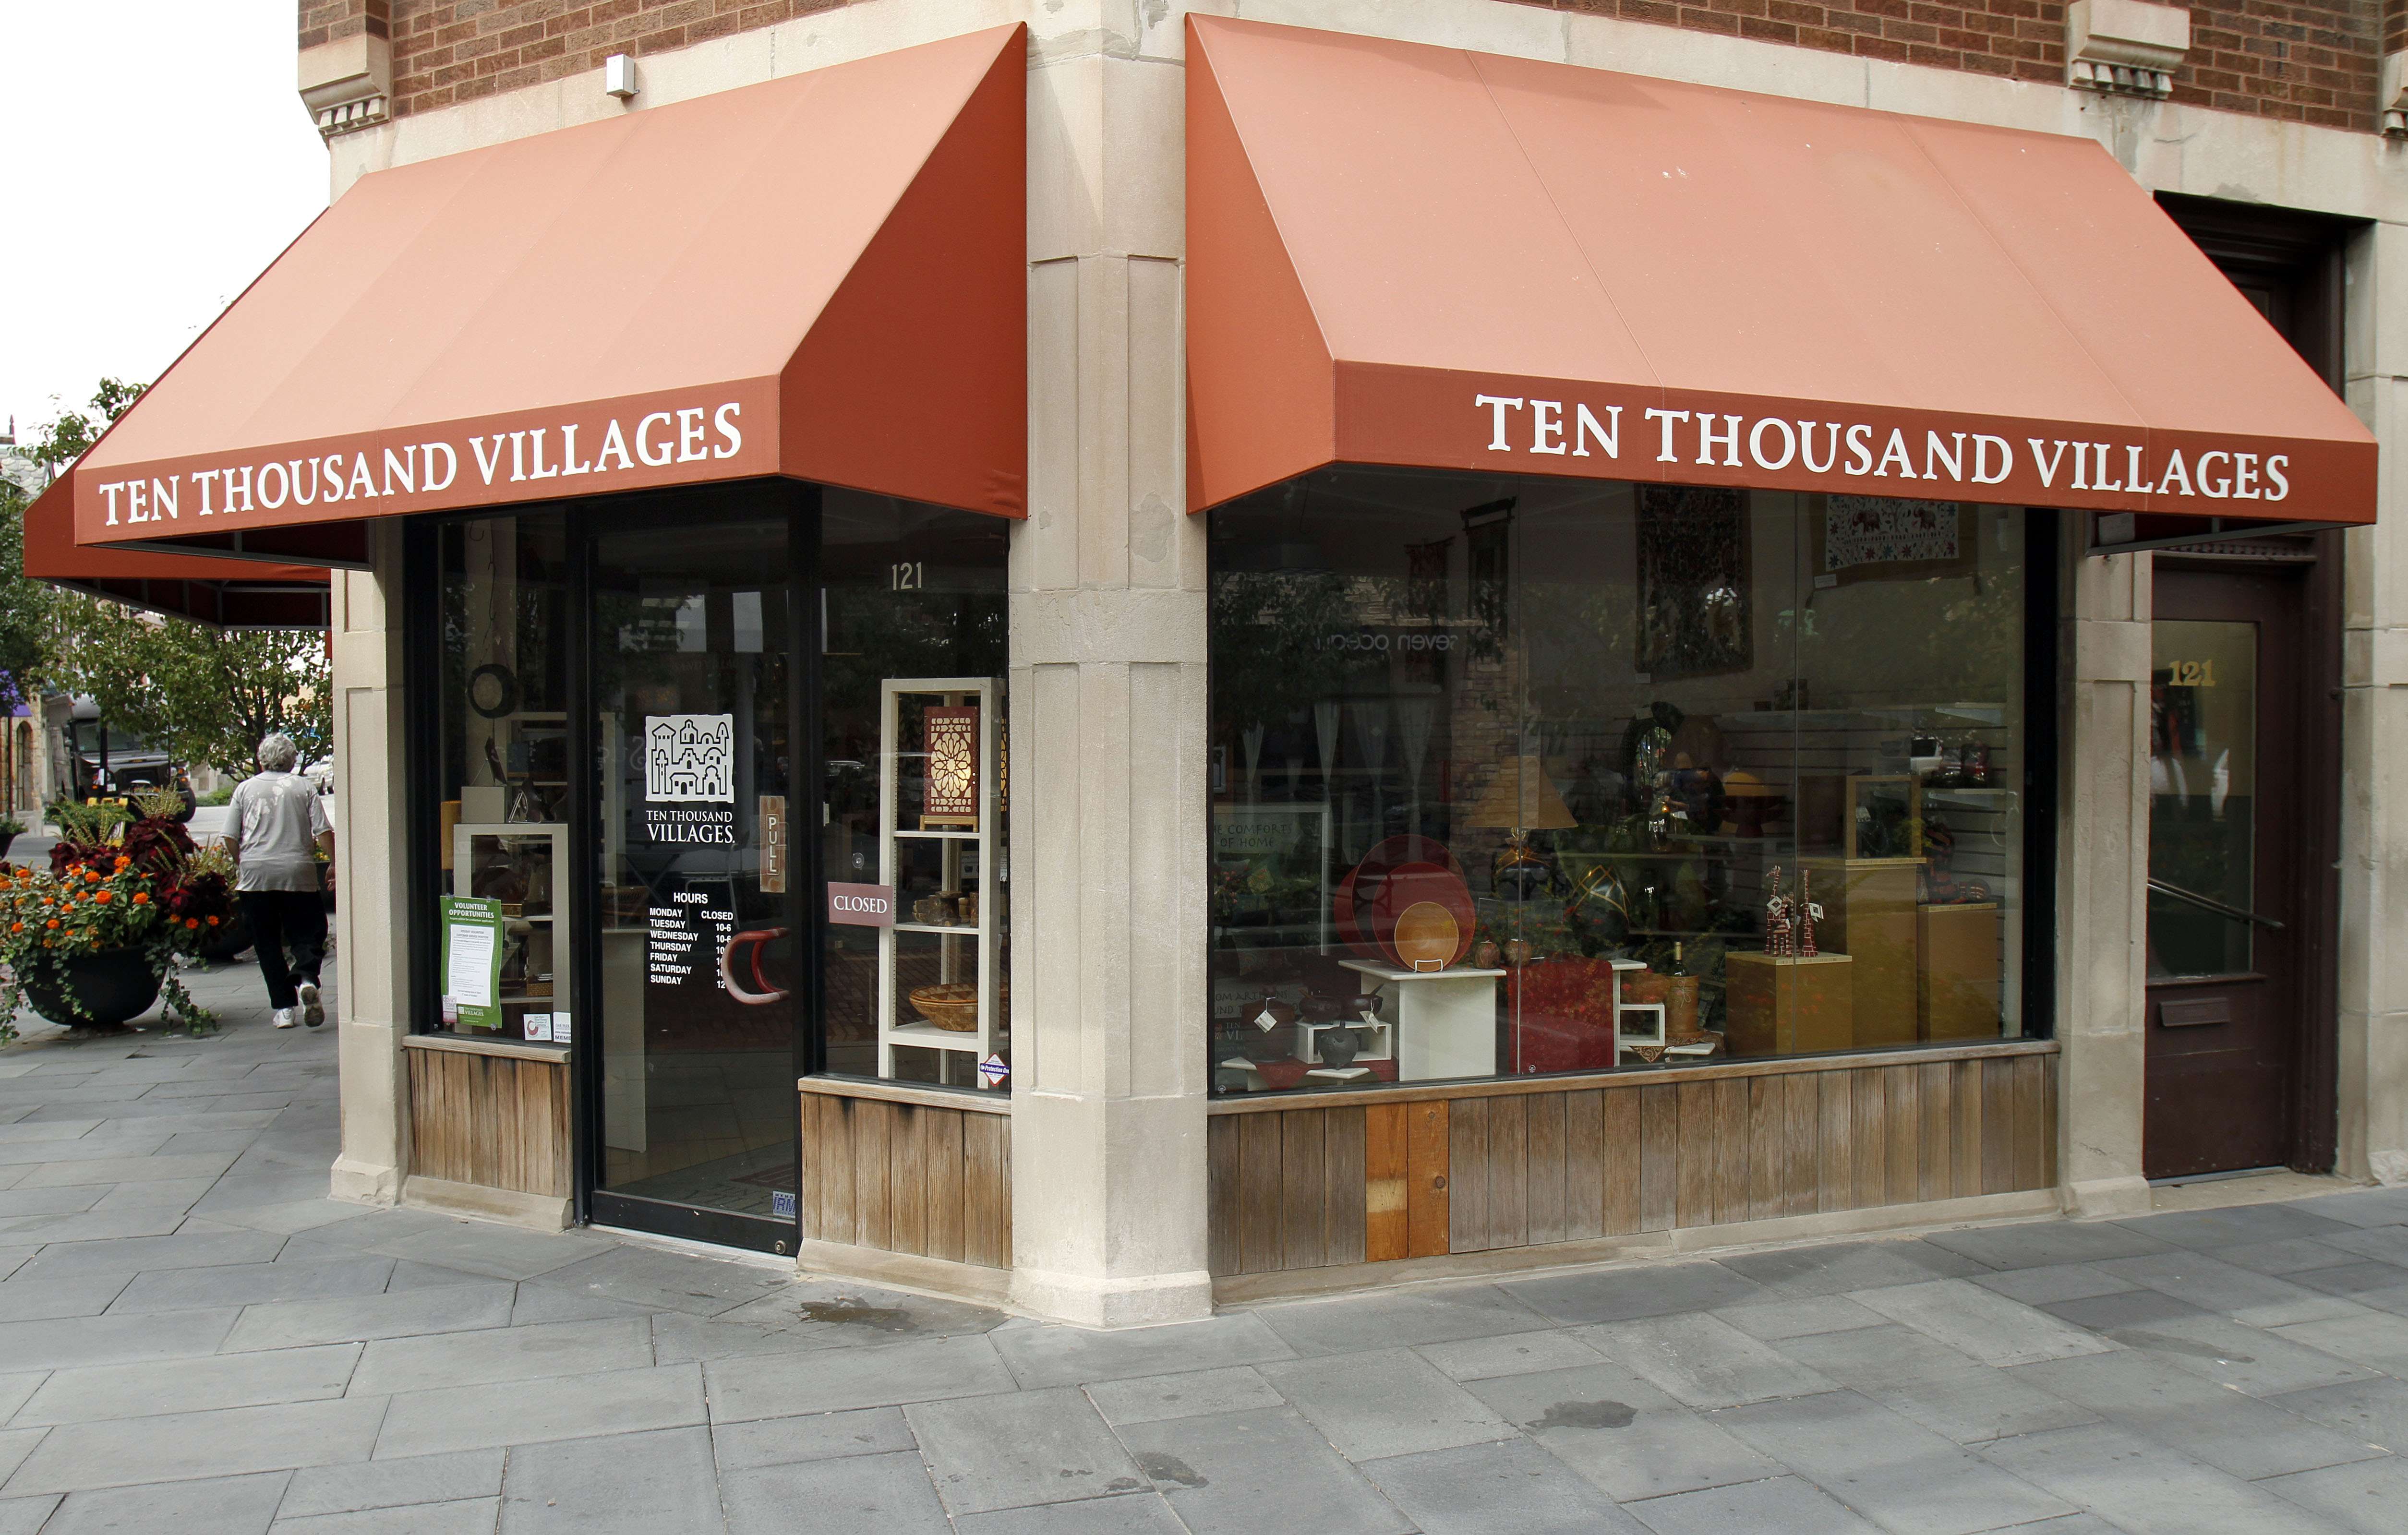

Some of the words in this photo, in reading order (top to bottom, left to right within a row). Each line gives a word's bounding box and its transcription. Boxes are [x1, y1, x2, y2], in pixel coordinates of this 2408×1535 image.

[1475, 394, 1623, 459] TEN
[1645, 407, 2014, 484] THOUSAND
[2027, 438, 2289, 501] VILLAGES
[98, 475, 180, 527] TEN
[192, 440, 458, 516] THOUSAND
[468, 402, 742, 486] VILLAGES
[891, 562, 922, 590] 121
[2168, 659, 2216, 687] 121
[646, 810, 667, 821] TEN
[669, 810, 733, 823] THOUSAND
[1228, 824, 1292, 835] COMFORTS
[768, 817, 777, 873] PULL
[1220, 837, 1234, 848] OF
[1240, 837, 1276, 848] HOME
[673, 892, 709, 904] HOURS
[833, 895, 887, 914] CLOSED
[454, 902, 488, 911] VOLUNTEER
[449, 909, 494, 919] OPPORTUNITIES
[650, 907, 683, 918] MONDAY
[701, 911, 734, 920] CLOSED
[650, 919, 686, 929] TUESDAY
[715, 923, 732, 932] 10-6
[650, 930, 699, 941] WEDNESDAY
[716, 935, 731, 943] 10-6
[650, 941, 692, 952] THURSDAY
[650, 952, 678, 962] FRIDAY
[650, 963, 692, 974] SATURDAY
[650, 974, 682, 985] SUNDAY
